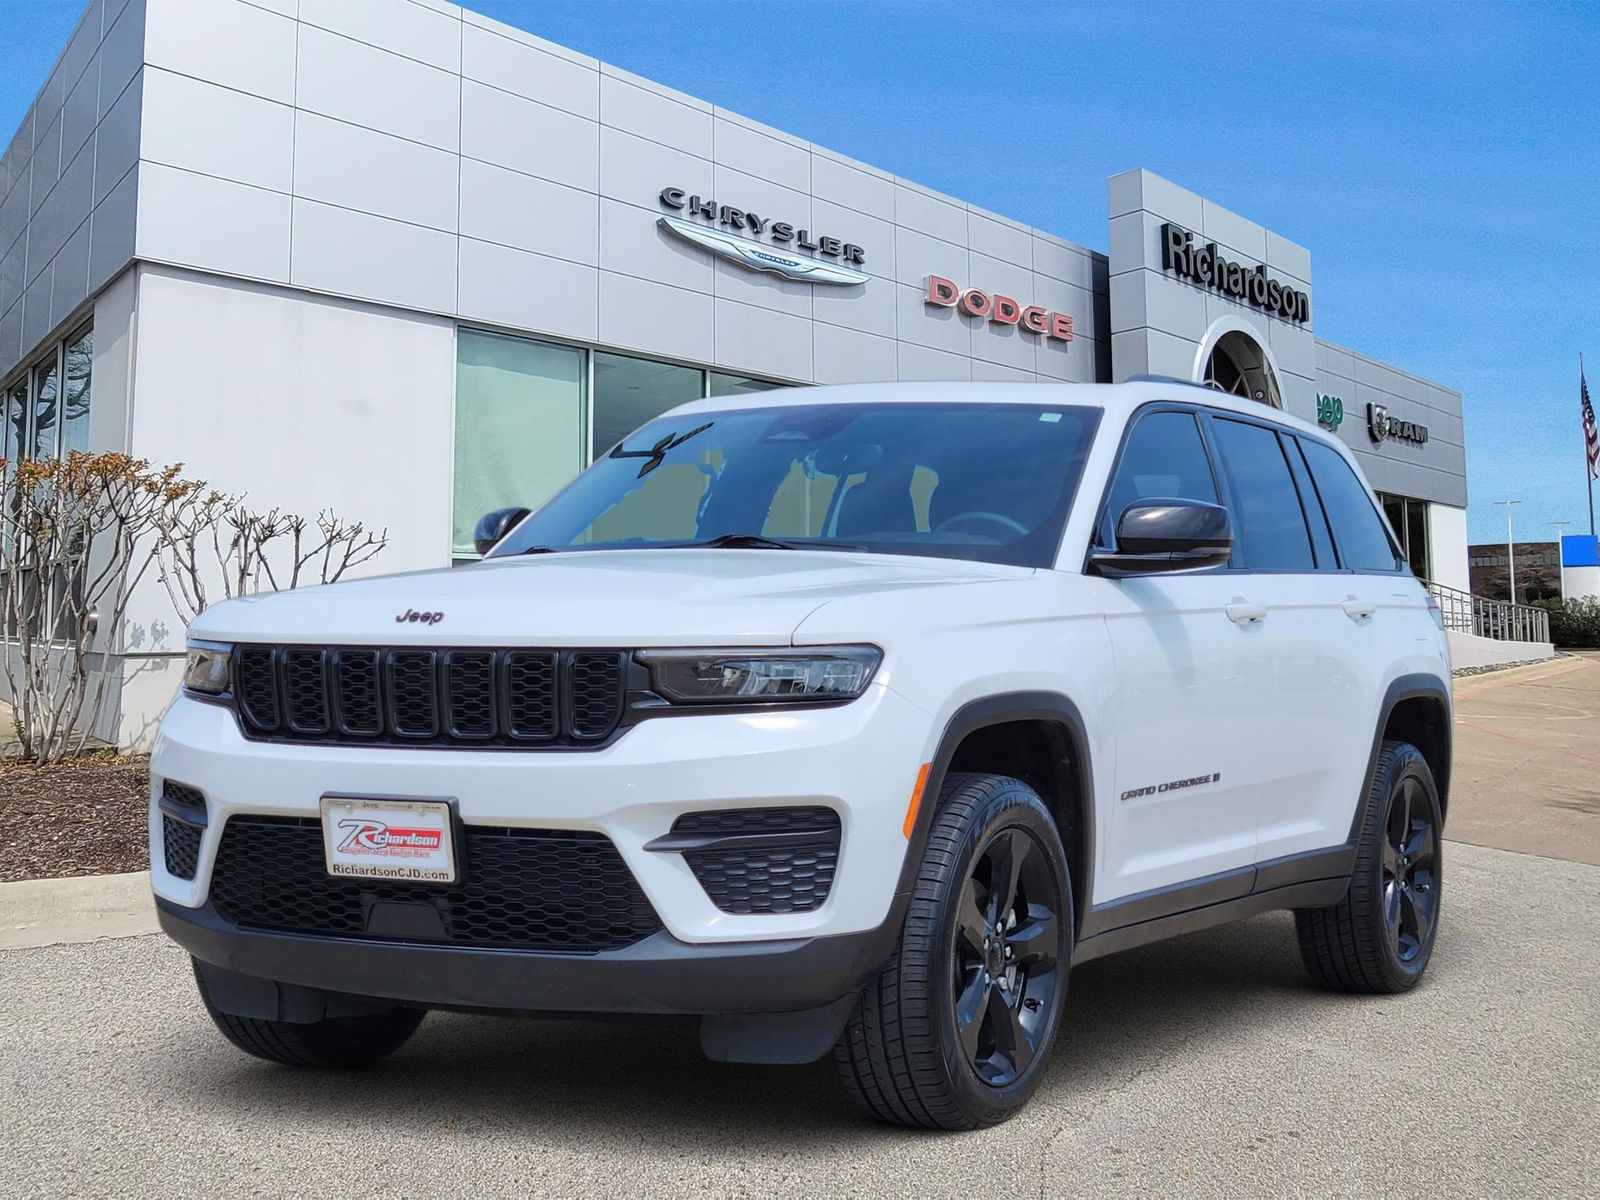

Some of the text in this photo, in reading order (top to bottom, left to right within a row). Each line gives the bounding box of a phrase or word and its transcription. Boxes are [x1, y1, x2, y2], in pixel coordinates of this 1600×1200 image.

[659, 186, 866, 264] CHRYSLER
[1161, 223, 1309, 323] Richardson
[923, 274, 1074, 342] DODGE
[1386, 416, 1429, 443] RAM
[396, 608, 444, 626] Jeep
[1120, 774, 1212, 801] GRAND CHEROKEE
[338, 818, 439, 852] Richardson
[333, 864, 449, 880] RichardsonCJD.com
